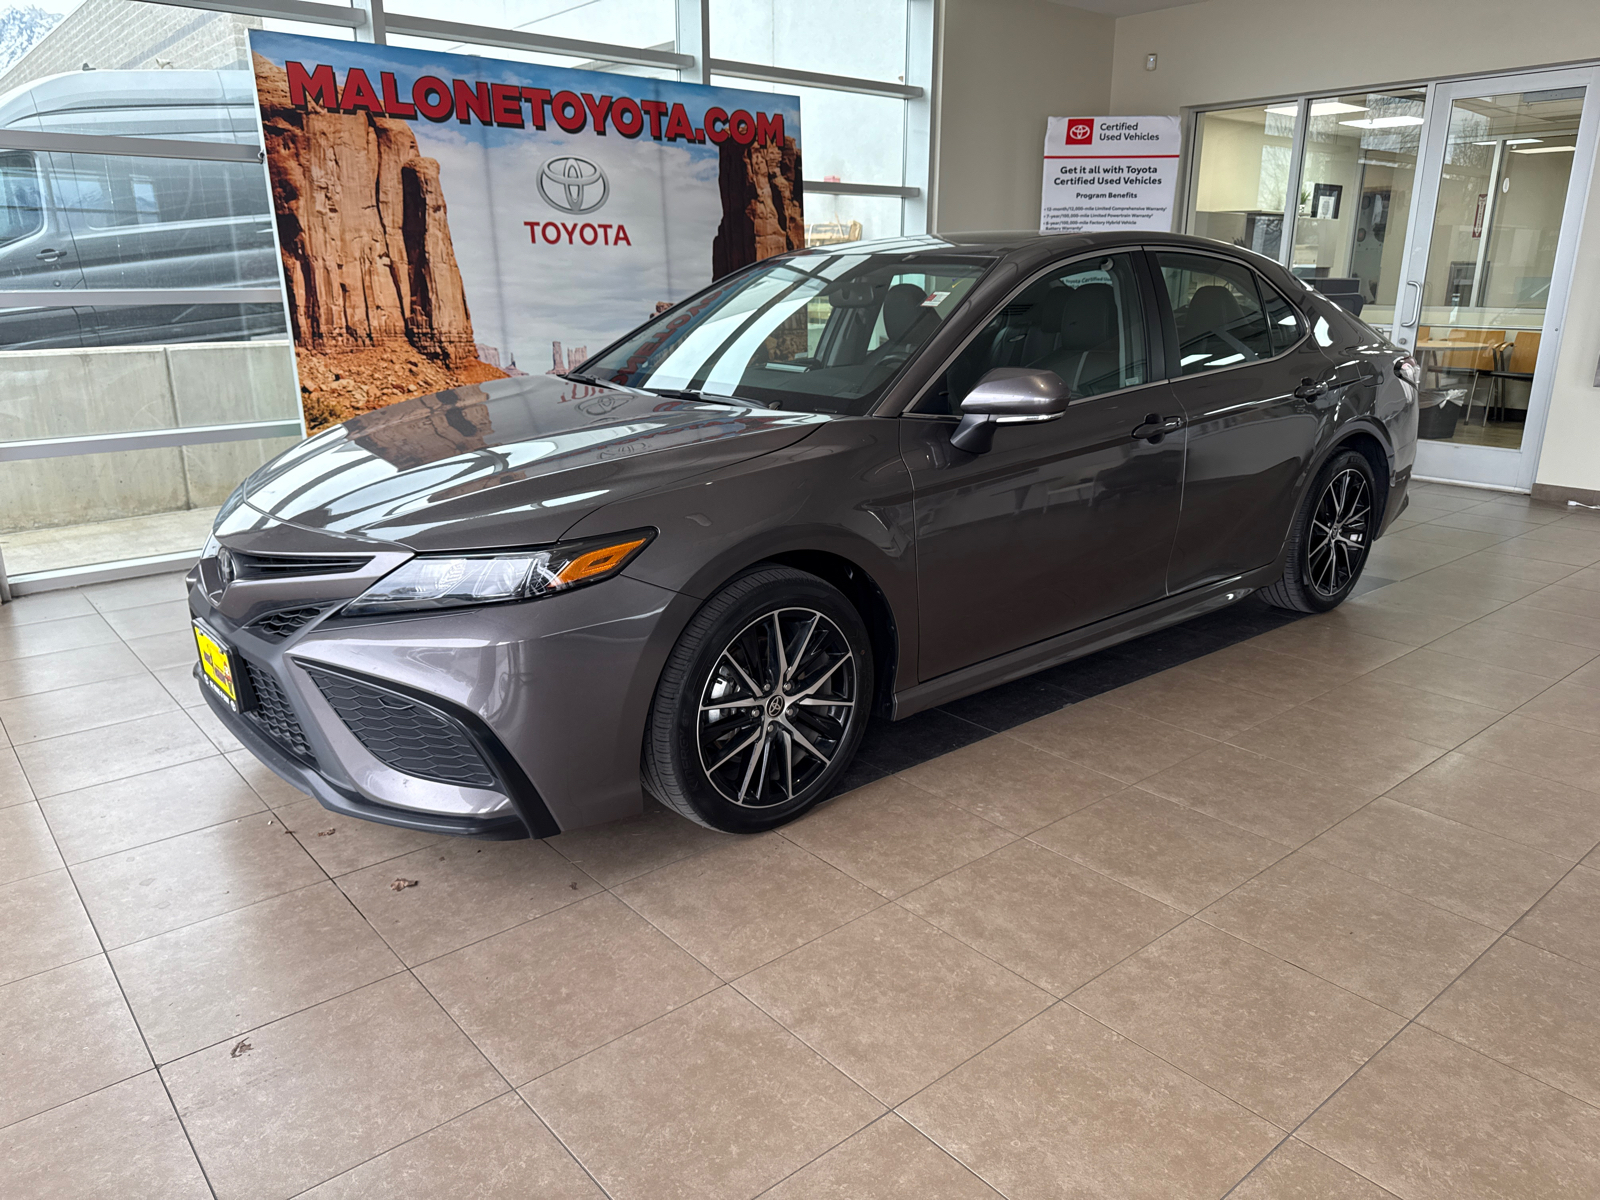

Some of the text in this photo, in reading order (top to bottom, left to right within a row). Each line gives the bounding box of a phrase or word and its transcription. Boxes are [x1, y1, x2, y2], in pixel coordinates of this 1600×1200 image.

[285, 60, 784, 149] MALONETOYOTA.COM
[1100, 122, 1139, 131] Certified
[1099, 132, 1160, 141] Used Vehicles
[1060, 165, 1158, 177] Get it all with Toyota
[1053, 176, 1162, 186] Certified Used Vehicles
[1075, 192, 1107, 200] Program
[523, 221, 632, 247] TOYOTA
